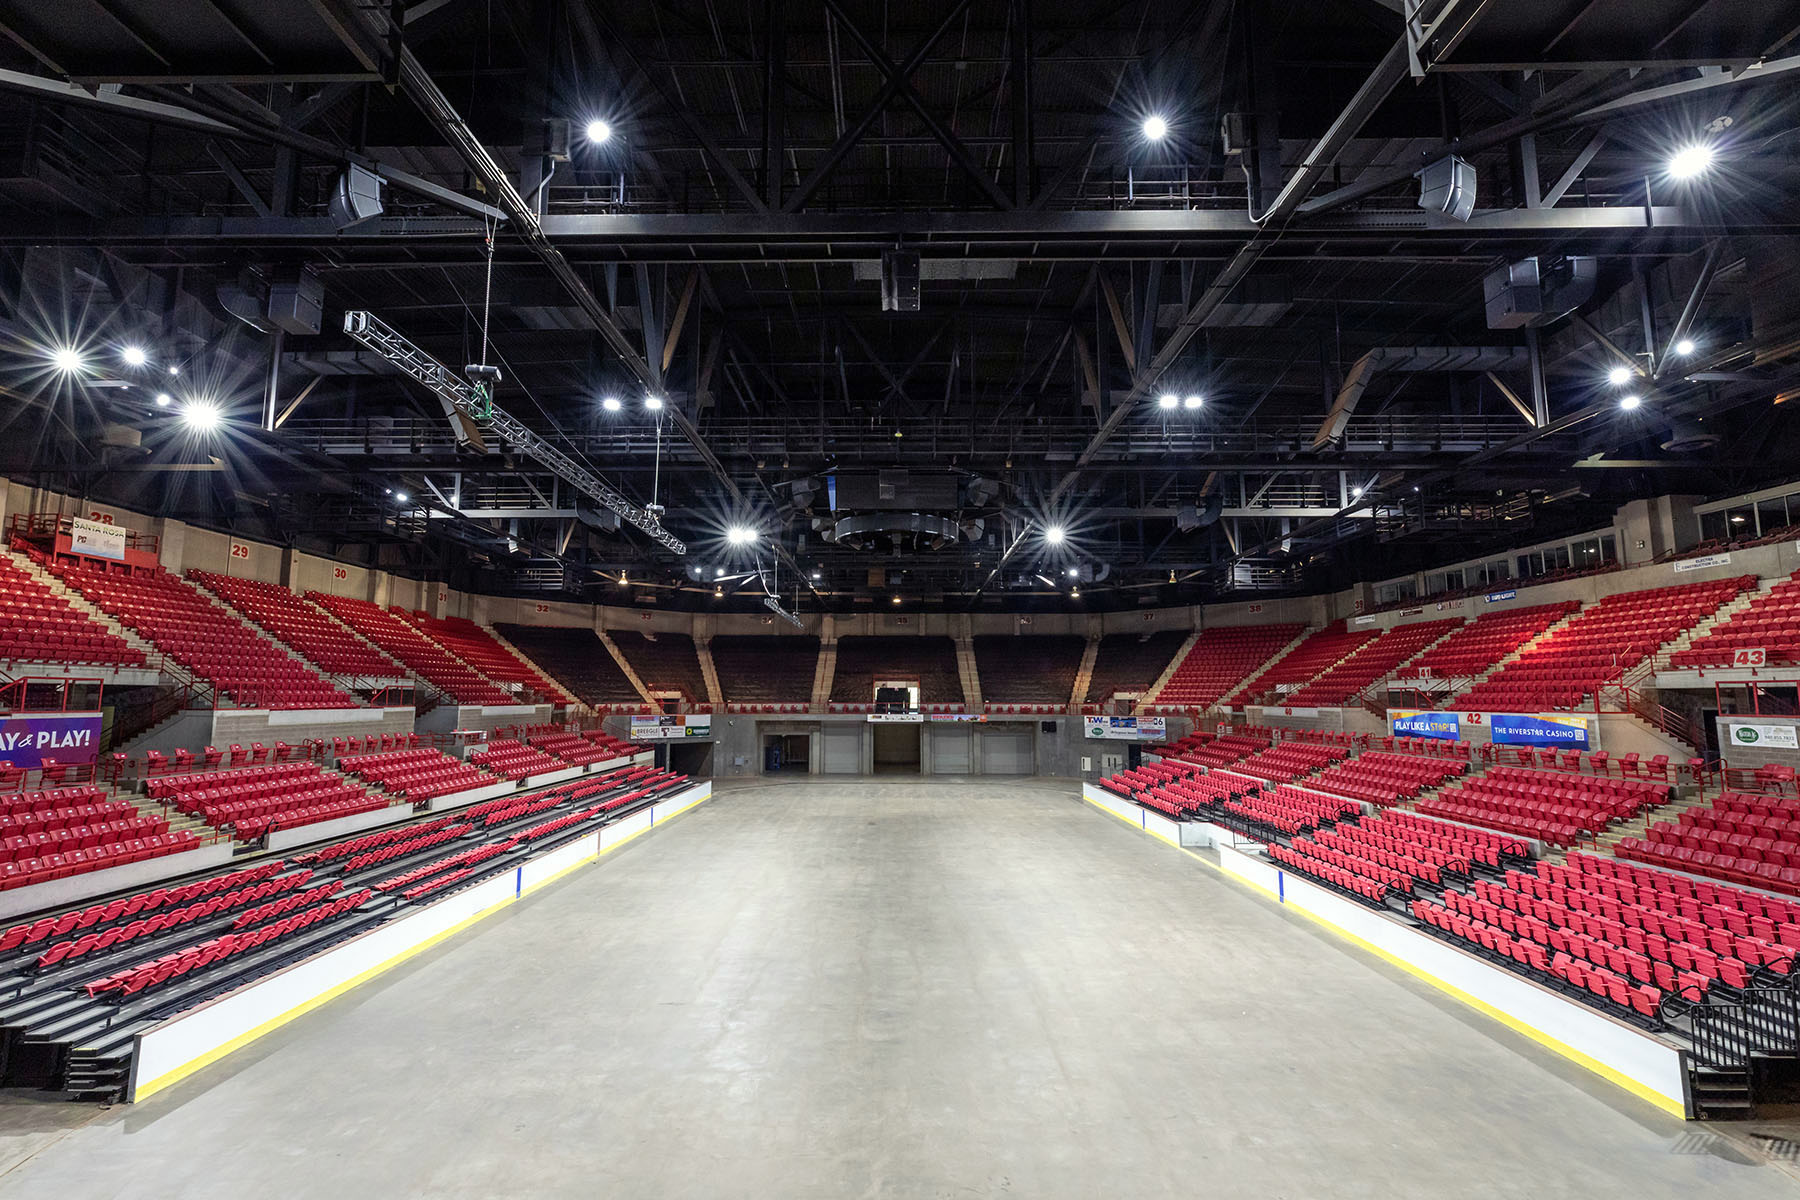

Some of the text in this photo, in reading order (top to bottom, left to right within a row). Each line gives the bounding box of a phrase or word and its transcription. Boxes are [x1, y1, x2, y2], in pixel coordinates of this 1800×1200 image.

[90, 511, 113, 526] 28
[74, 521, 101, 534] SANTA
[232, 545, 249, 558] 29
[334, 568, 347, 579] 30
[536, 604, 549, 613] 32
[1249, 605, 1262, 613] 38
[1735, 650, 1764, 665] 43
[1420, 668, 1430, 678] 41
[1466, 713, 1482, 725] 42
[1395, 721, 1411, 731] PLAY
[1411, 722, 1424, 731] LIKE
[1425, 722, 1431, 731] A
[1494, 727, 1574, 738] THE RIVERSTAR CASINO
[18, 734, 34, 748] &
[36, 729, 91, 749] PLAY!
[1677, 765, 1691, 774] 12
